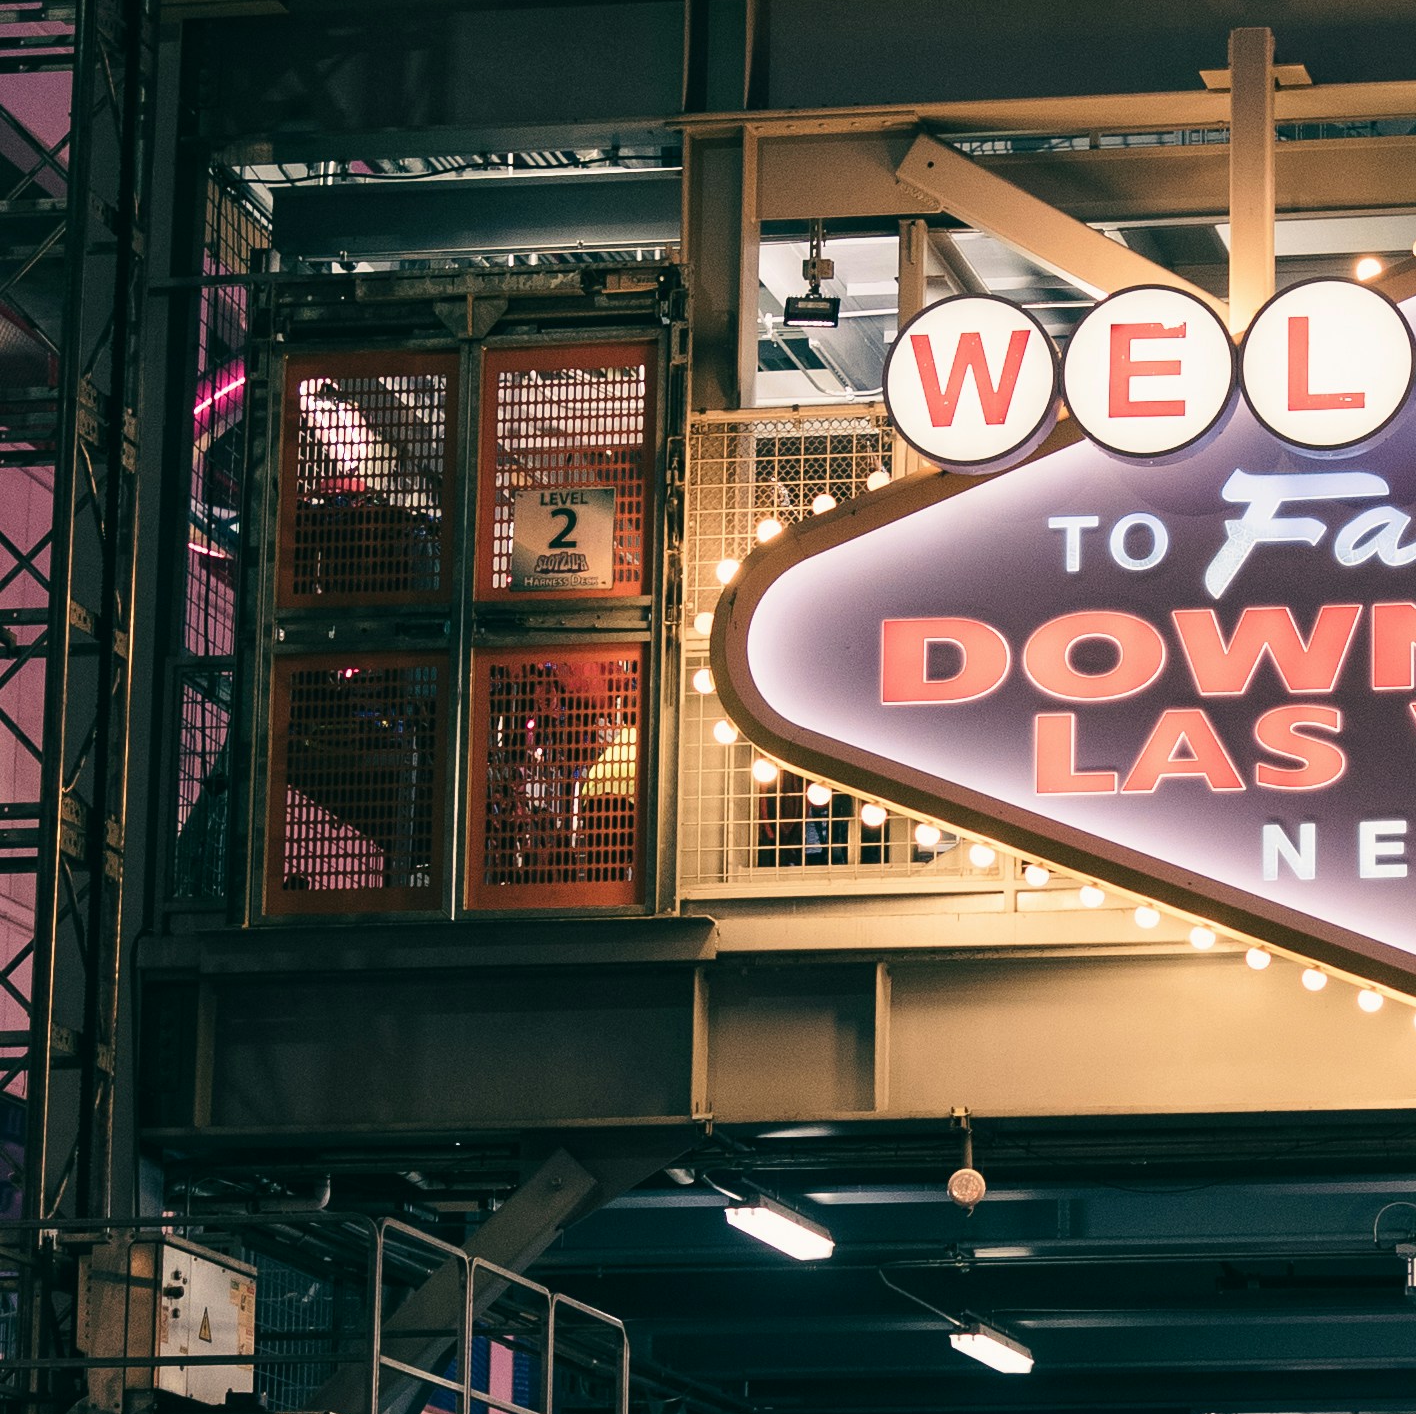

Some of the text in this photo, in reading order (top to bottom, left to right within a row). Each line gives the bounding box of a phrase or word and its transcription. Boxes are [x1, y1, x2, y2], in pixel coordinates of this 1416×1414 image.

[540, 492, 588, 506] LEVEL
[548, 508, 577, 549] 2
[1048, 512, 1169, 572] TO
[1034, 705, 1346, 796] LAS
